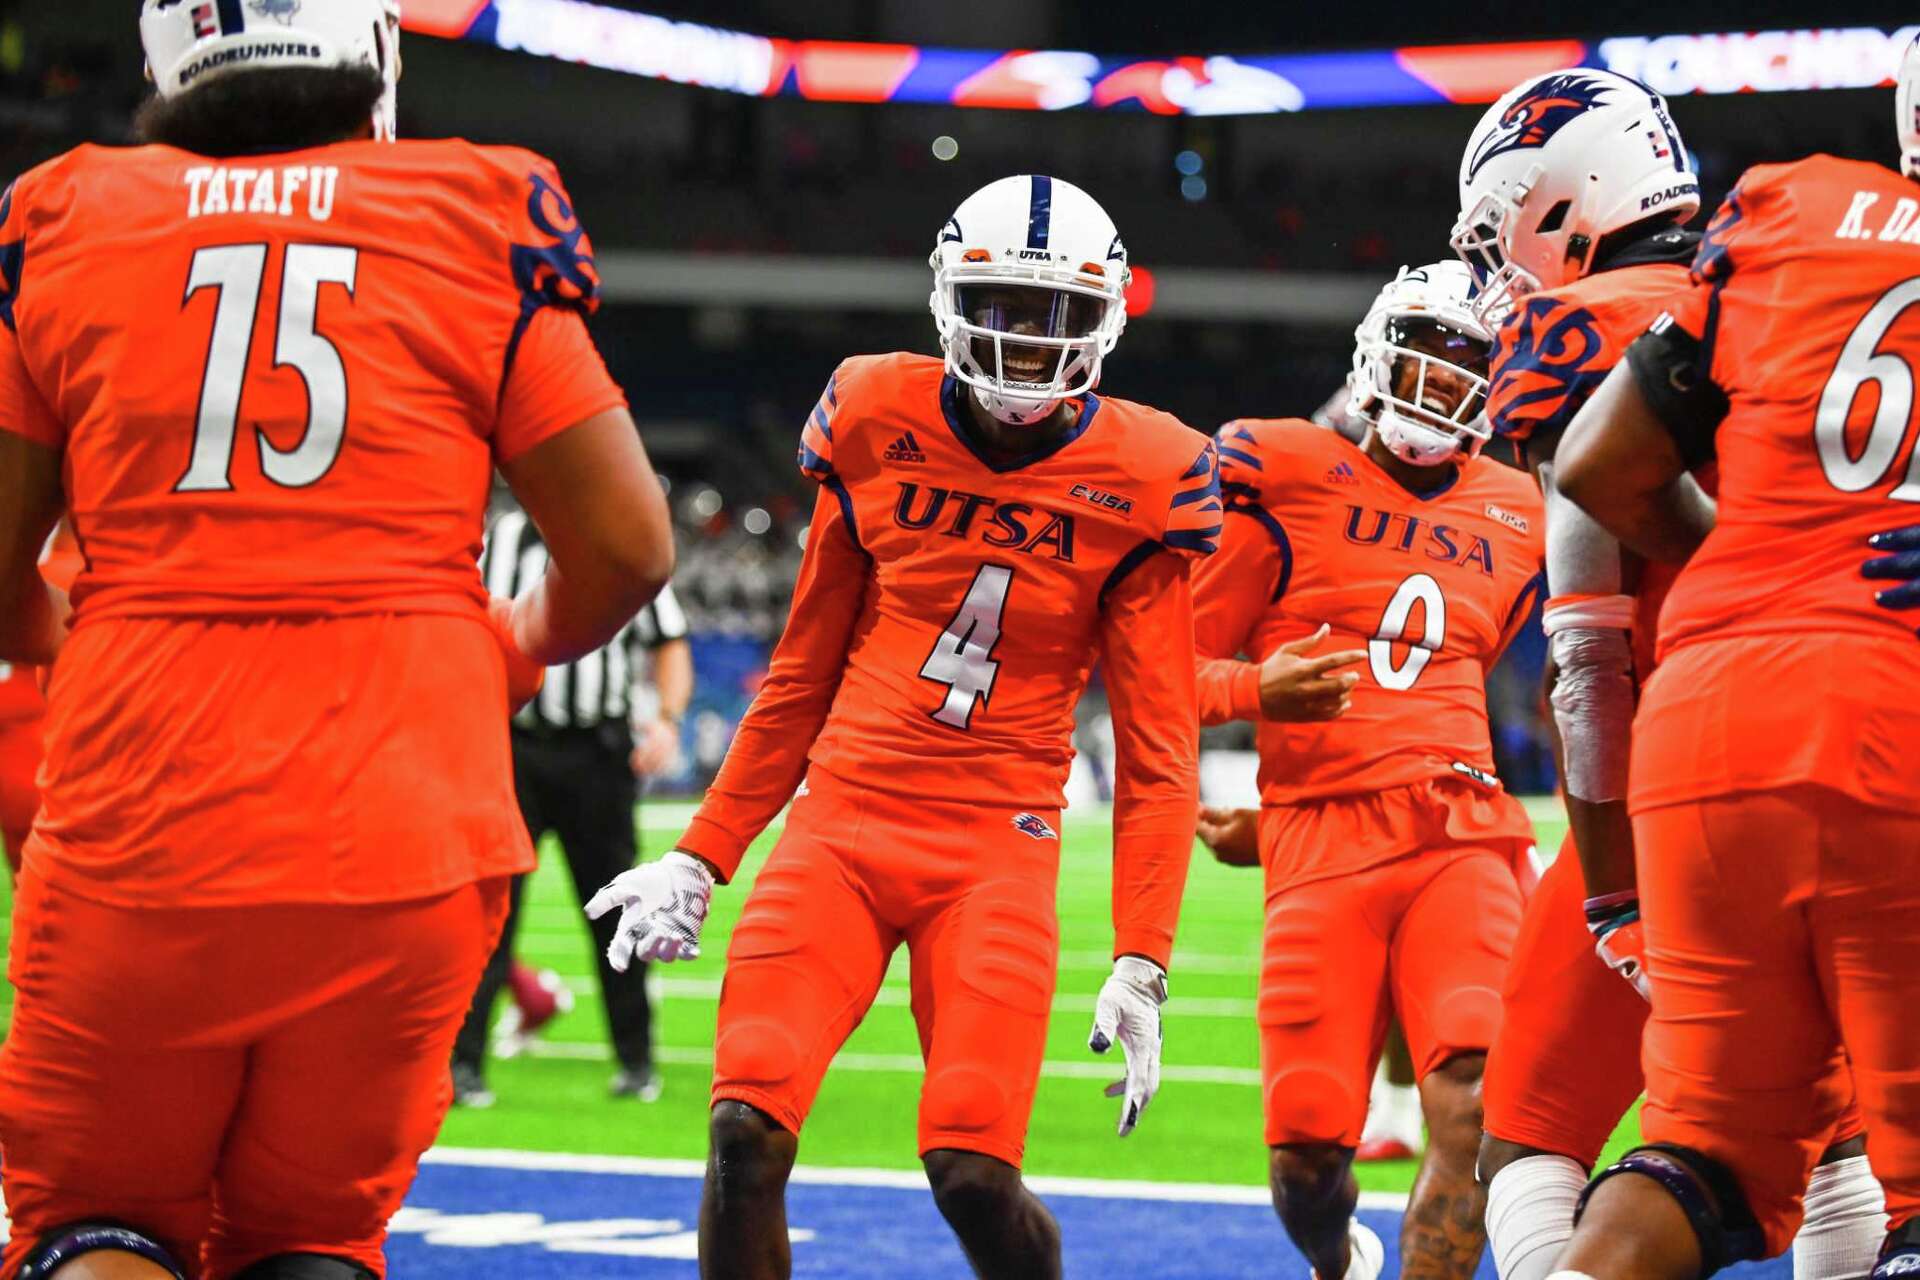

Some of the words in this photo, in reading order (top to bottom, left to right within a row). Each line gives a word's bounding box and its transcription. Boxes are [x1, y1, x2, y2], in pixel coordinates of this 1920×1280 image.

[179, 43, 321, 85] ROADRUNNERS
[184, 166, 339, 221] TATAFU
[1834, 191, 1879, 239] K.
[1019, 250, 1051, 261] UTSA
[168, 242, 358, 493] 75
[1814, 276, 1920, 503] 6
[883, 450, 926, 463] adidas
[893, 482, 1076, 563] UTSA
[1344, 504, 1494, 578] UTSA
[919, 562, 1015, 731] 4
[1368, 573, 1446, 690] 0
